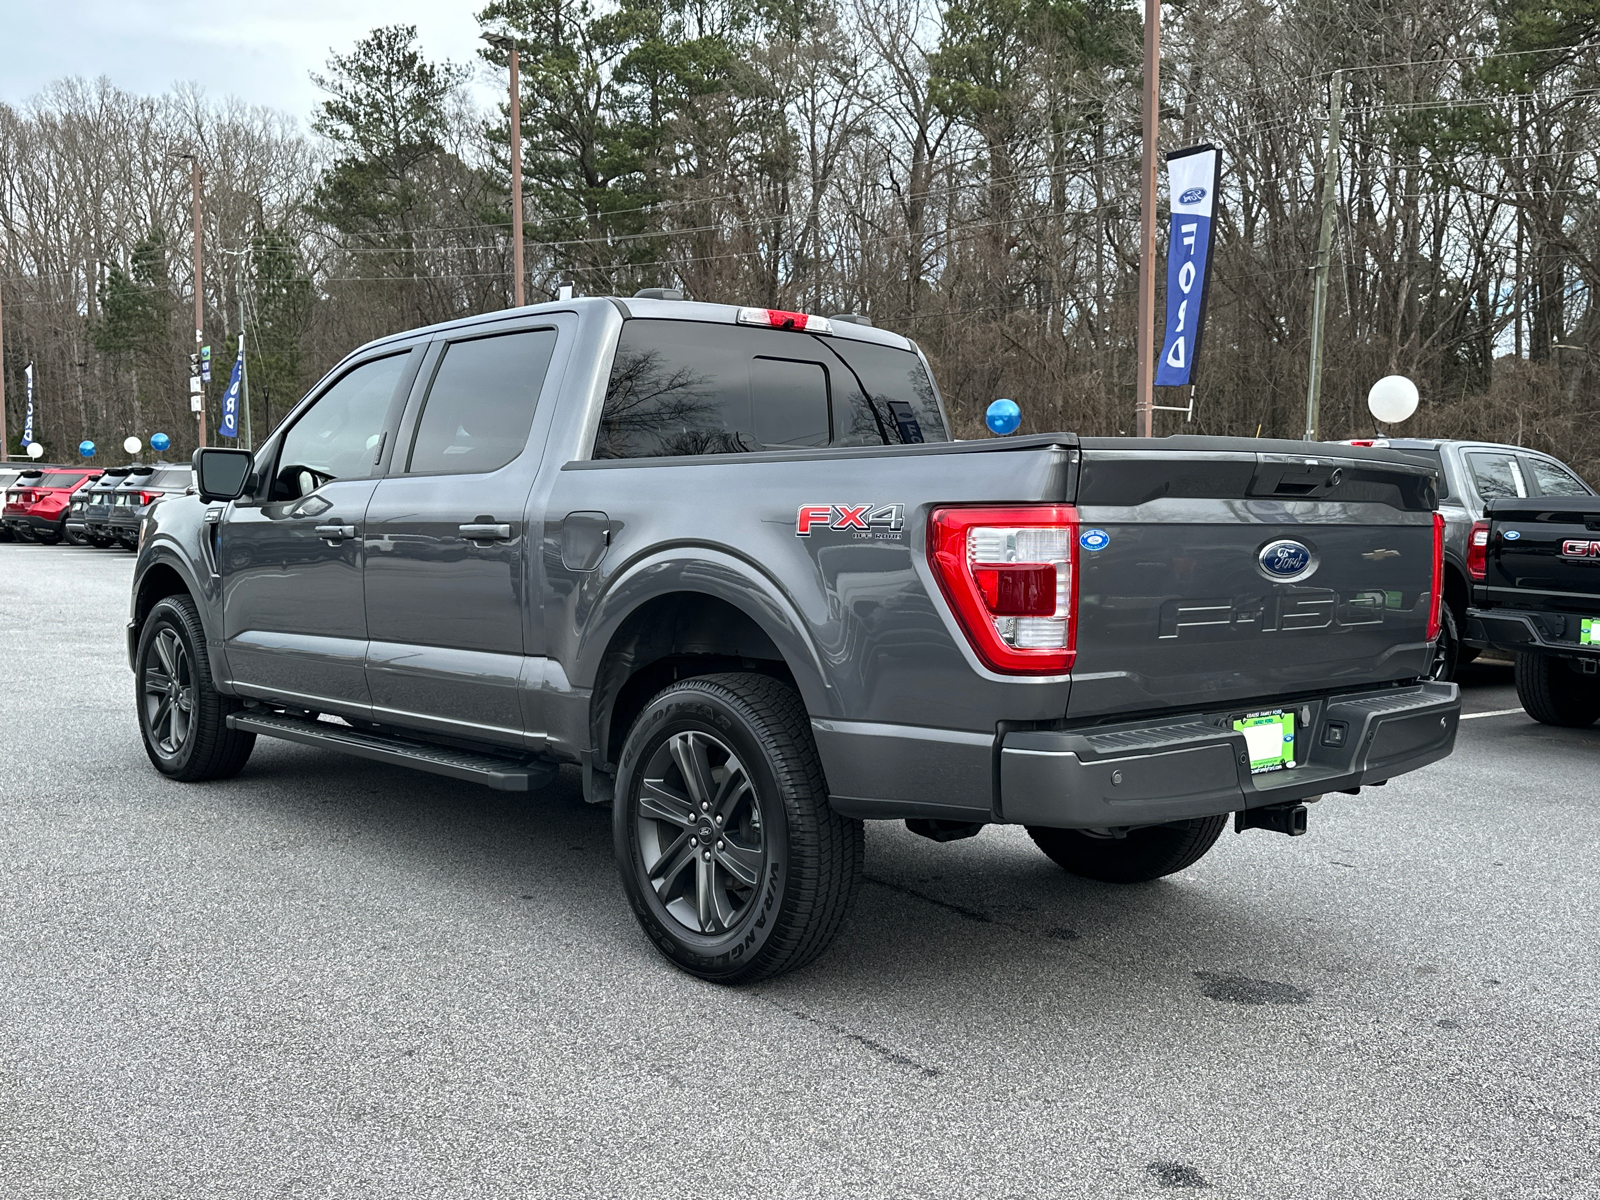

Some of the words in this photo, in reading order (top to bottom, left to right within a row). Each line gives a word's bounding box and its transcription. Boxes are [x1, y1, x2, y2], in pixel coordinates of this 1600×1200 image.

[795, 503, 905, 538] FX4
[1272, 546, 1306, 571] Ford
[1158, 588, 1387, 640] F-150
[687, 862, 780, 970] WRANGLER
